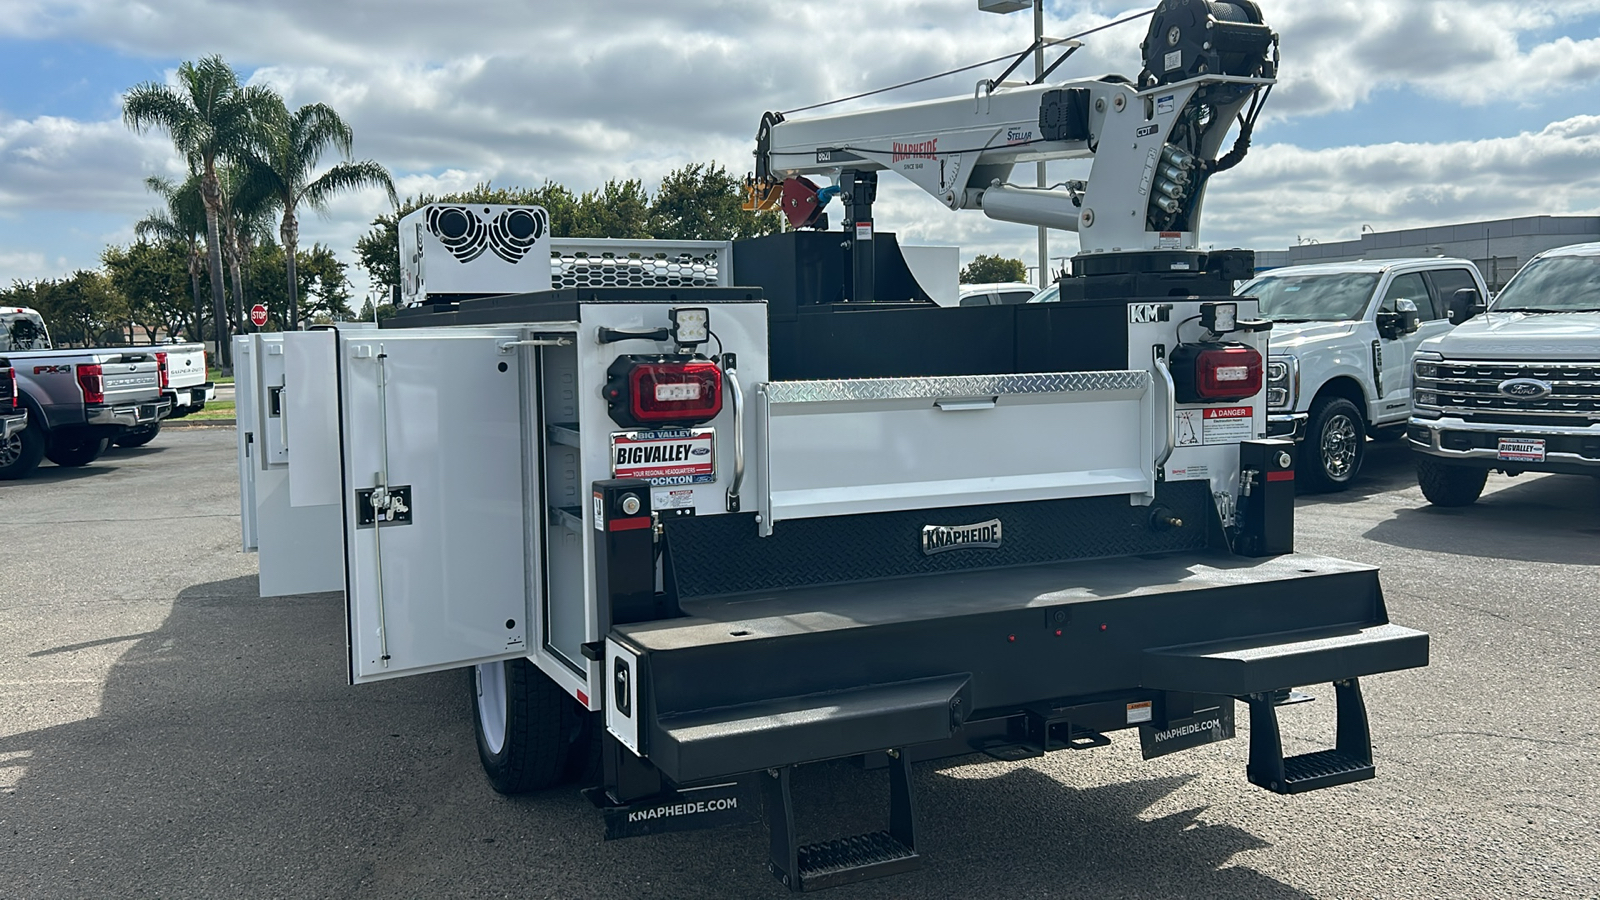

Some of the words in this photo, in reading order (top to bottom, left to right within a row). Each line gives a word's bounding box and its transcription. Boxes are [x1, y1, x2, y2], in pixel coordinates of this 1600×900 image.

[1007, 130, 1033, 141] STELLAR
[1136, 126, 1152, 137] CDT
[892, 138, 938, 163] KNAPHEIDE
[252, 311, 267, 320] STOP
[1130, 303, 1174, 324] KMT
[33, 364, 72, 375] FX4
[1510, 384, 1536, 395] Ford
[1218, 408, 1246, 417] DANGER
[638, 432, 655, 440] BIG
[657, 430, 691, 439] VALLEY
[1500, 443, 1535, 453] BIGVALLEY
[616, 443, 693, 465] BIGVALLEY
[644, 469, 665, 477] REGIONAL
[664, 467, 696, 476] HEADQUARTERS
[640, 475, 694, 486] TOCKTON
[926, 523, 998, 551] KNAPHEIDE
[1154, 718, 1220, 743] KNAPHEIDE.COM
[628, 797, 738, 822] KNAPHEIDE.COM
